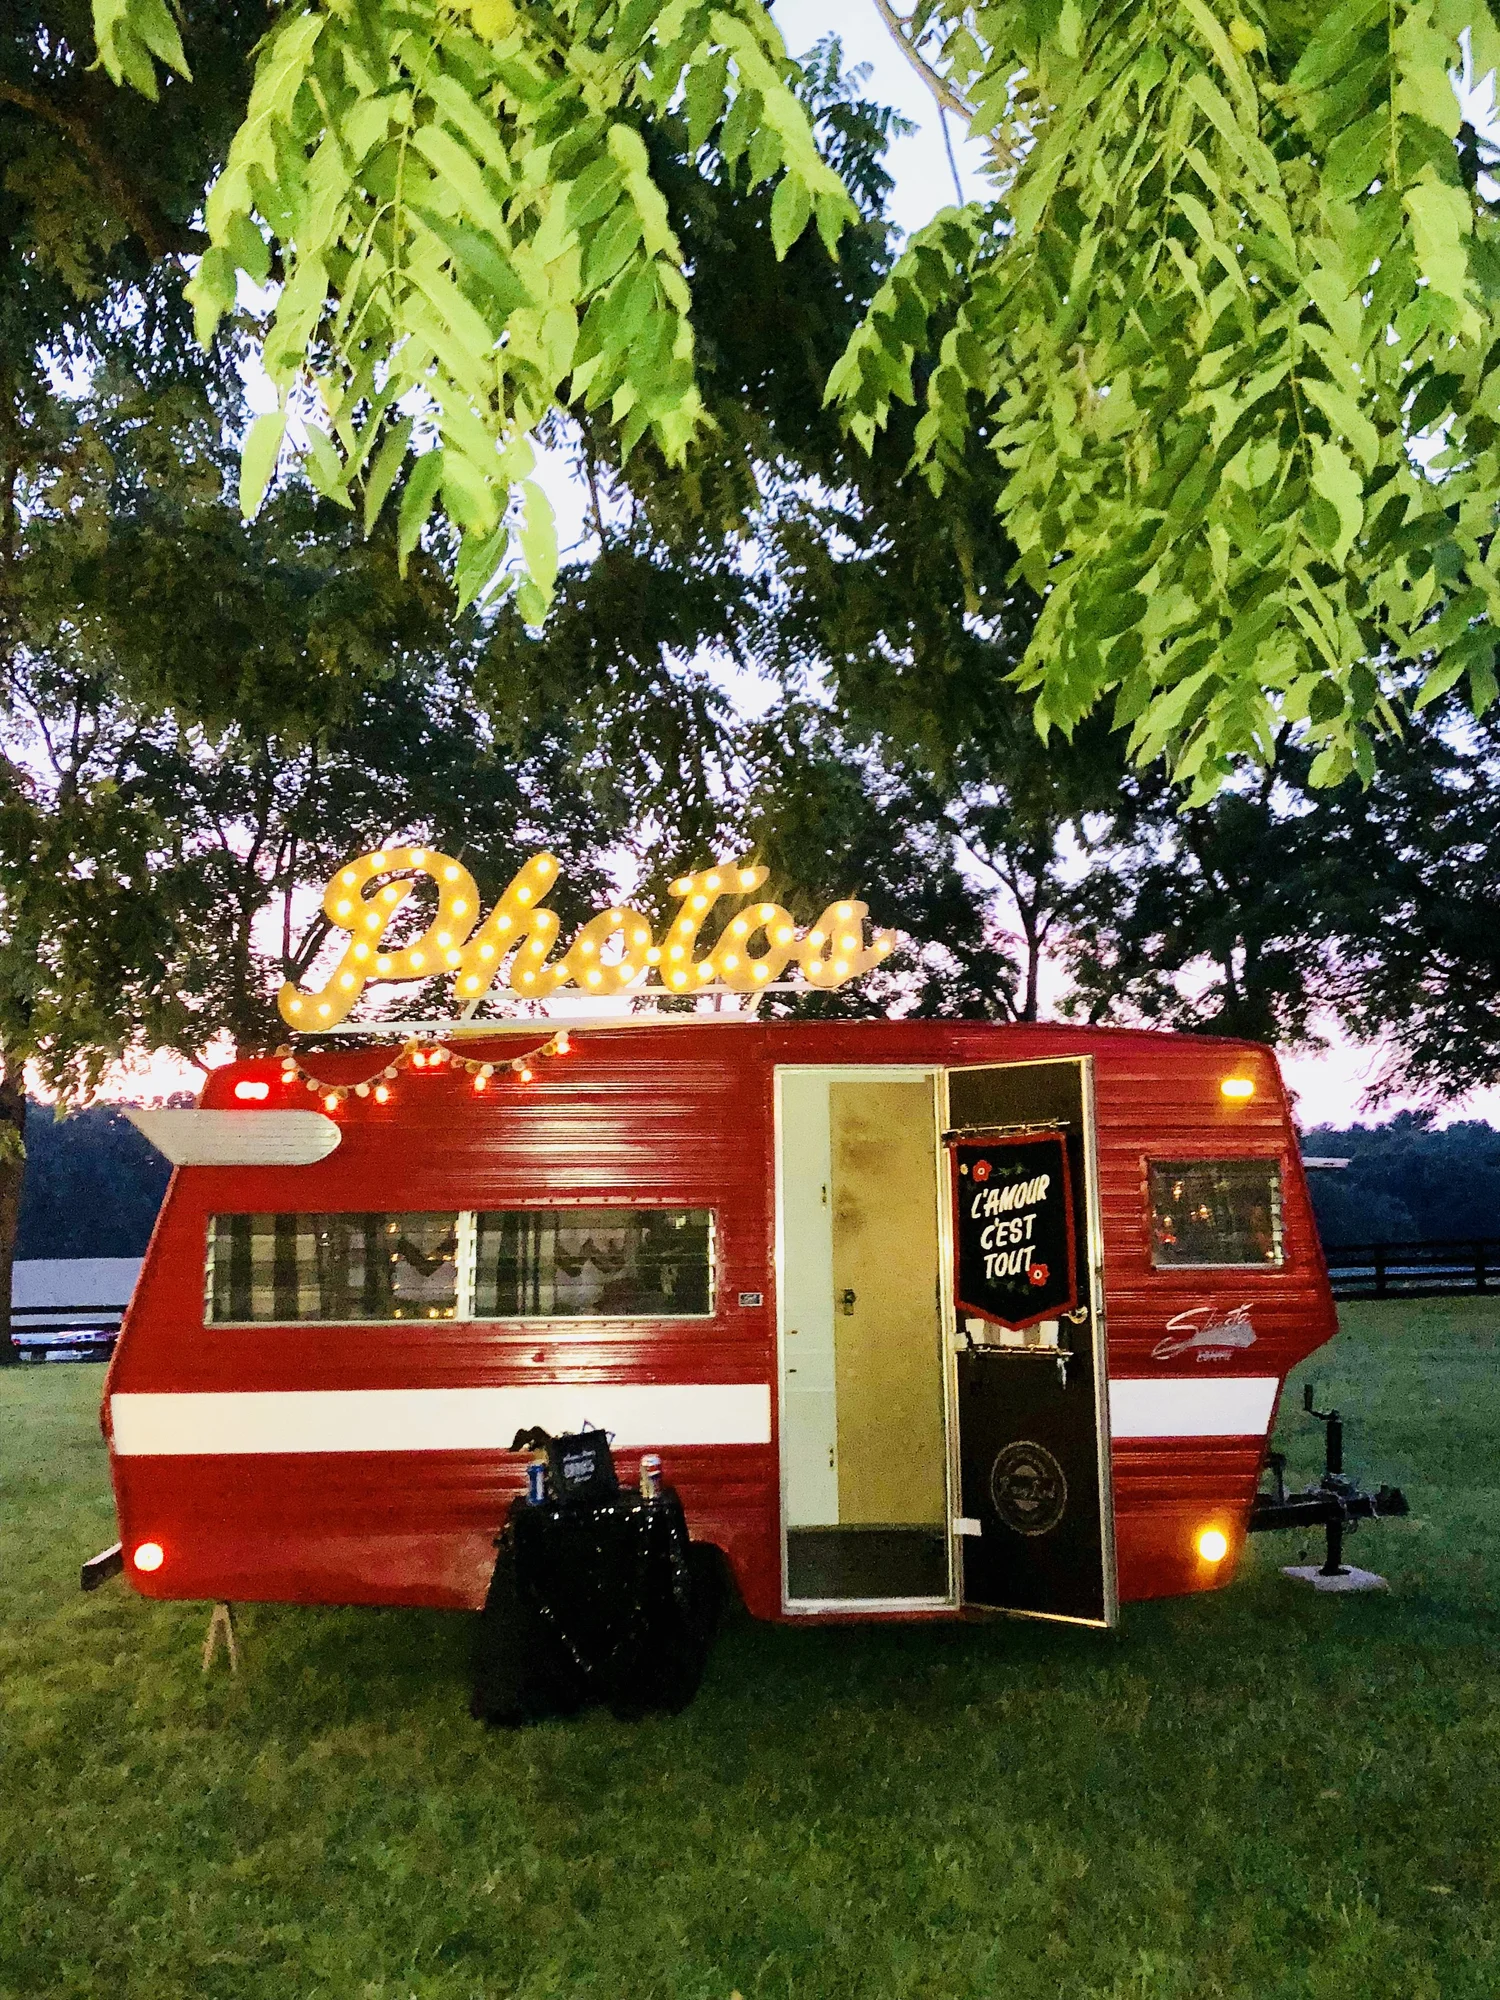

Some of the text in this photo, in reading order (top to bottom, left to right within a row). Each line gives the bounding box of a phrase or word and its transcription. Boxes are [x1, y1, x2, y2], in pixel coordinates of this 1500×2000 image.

[278, 847, 896, 1032] Photos
[971, 1174, 1051, 1219] L'AMOUR
[980, 1213, 1037, 1251] C'EST
[983, 1245, 1036, 1280] TOUT
